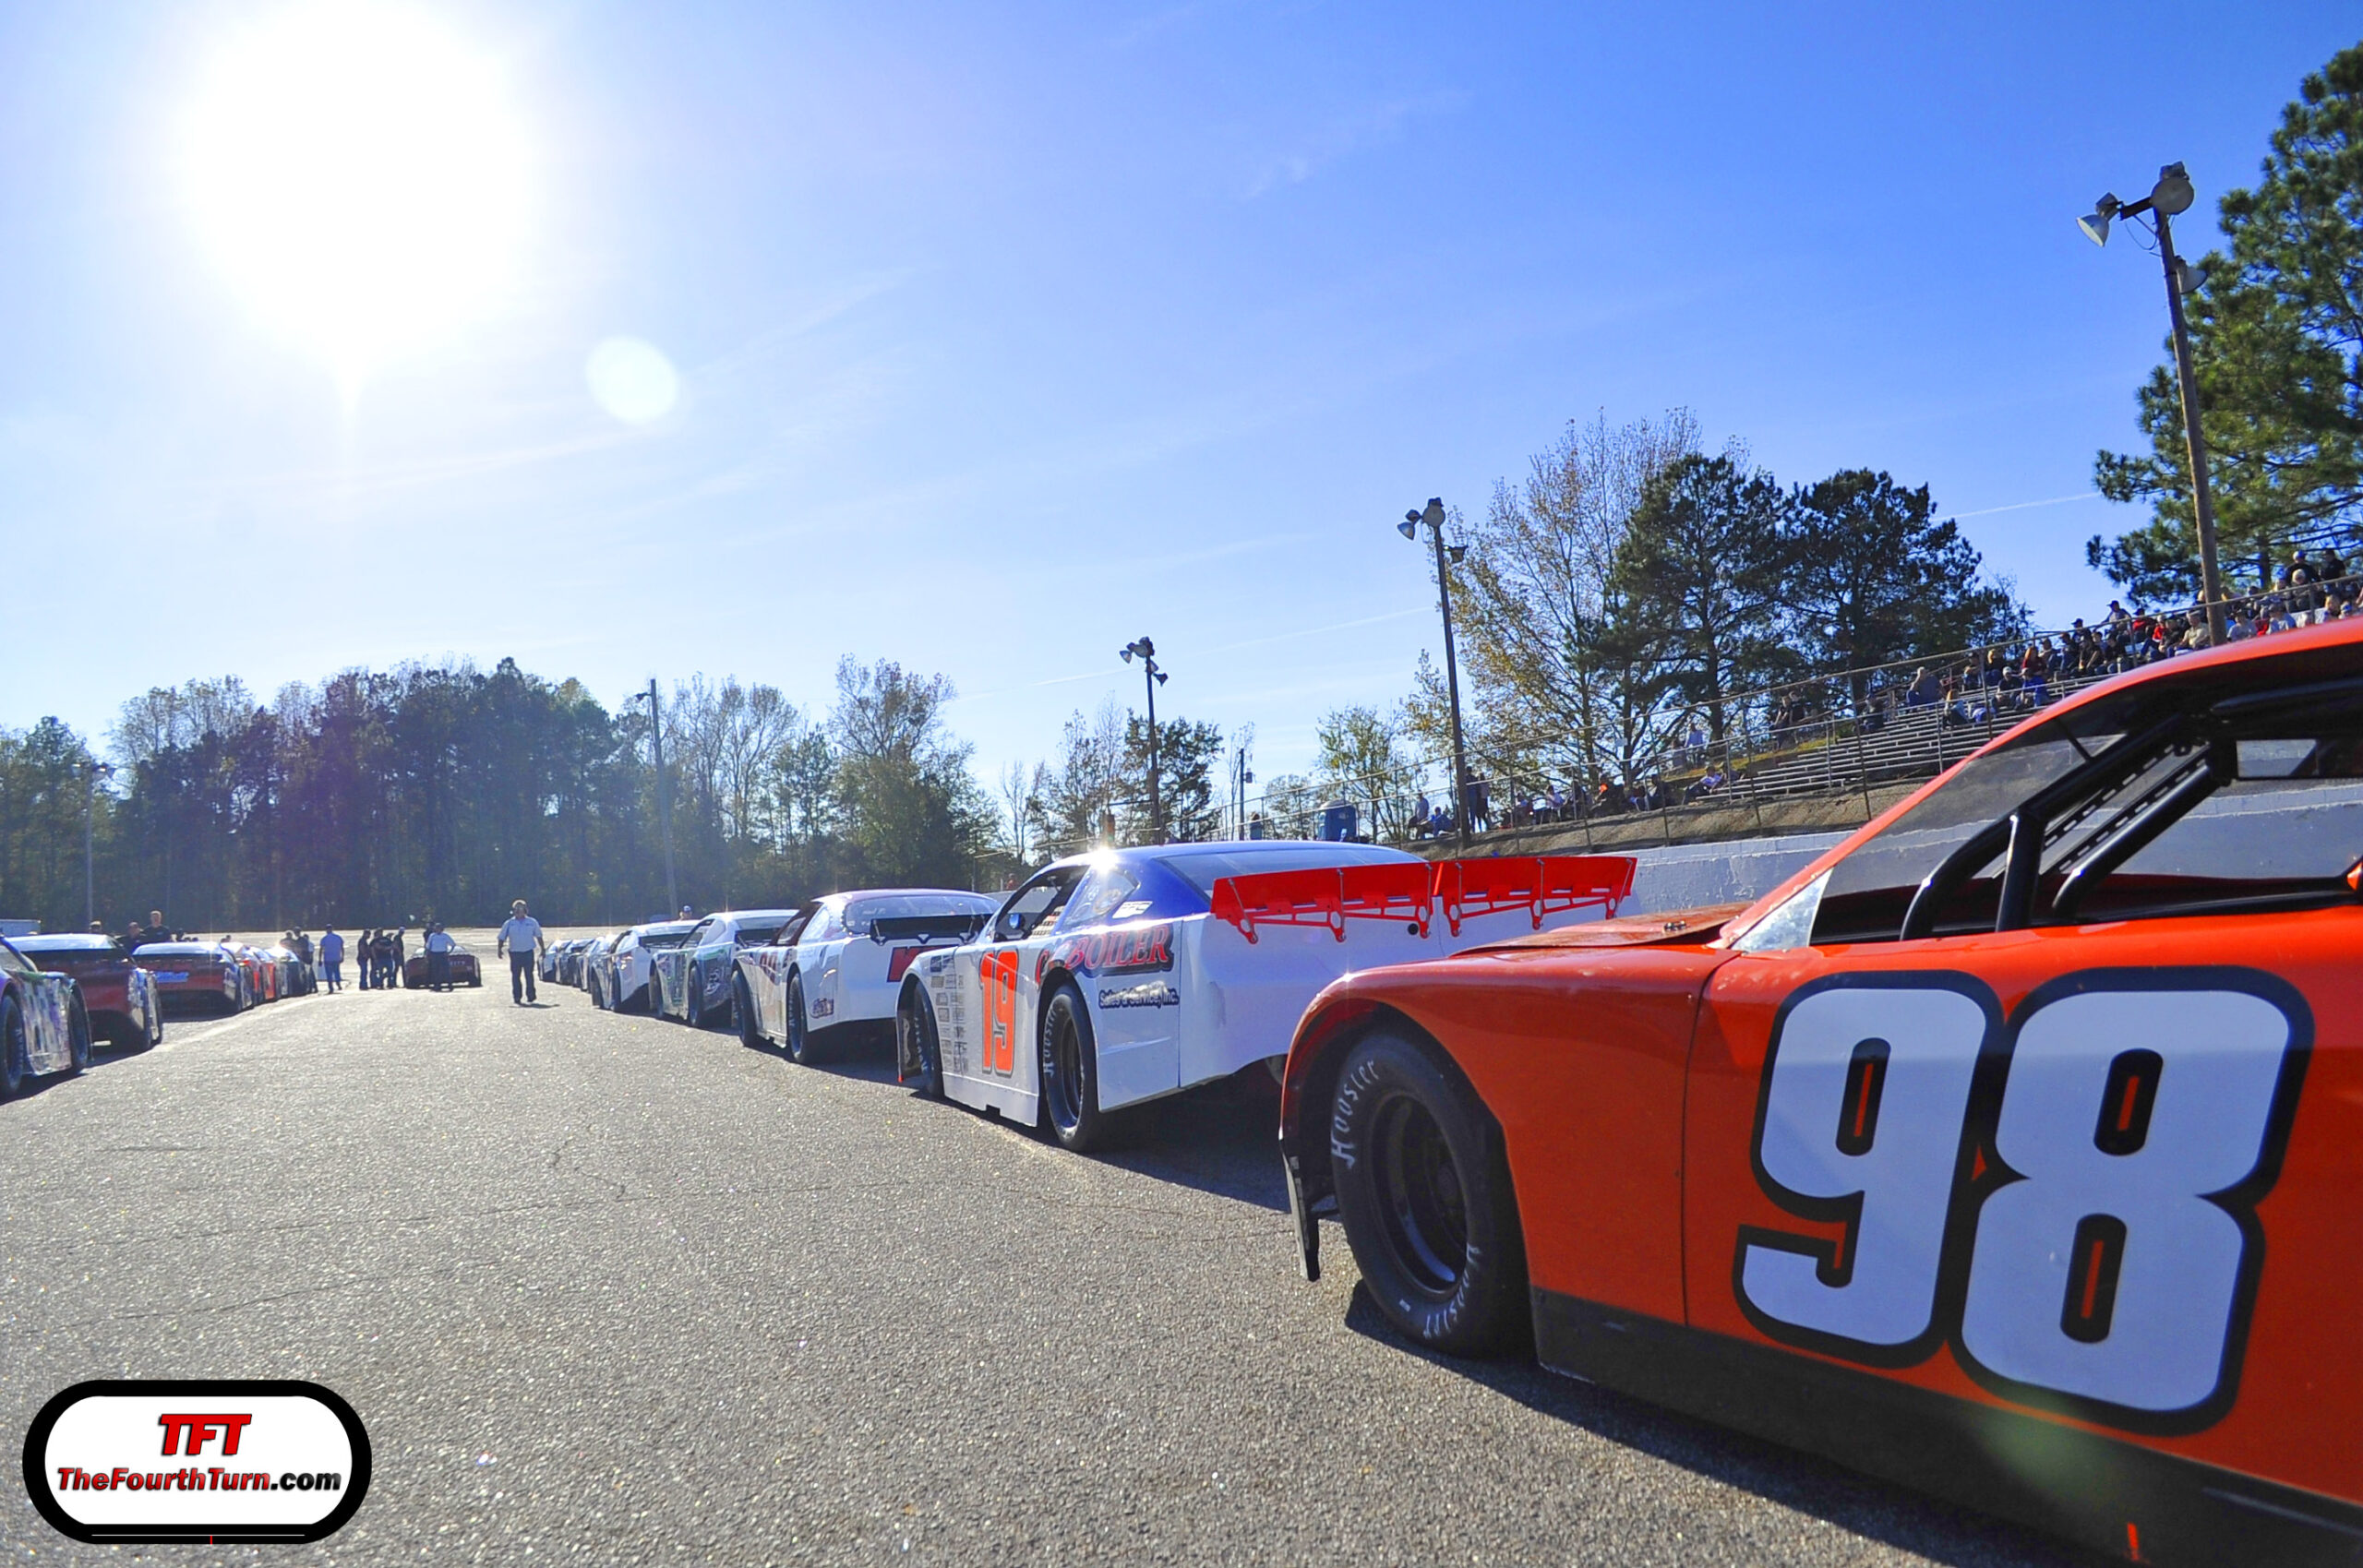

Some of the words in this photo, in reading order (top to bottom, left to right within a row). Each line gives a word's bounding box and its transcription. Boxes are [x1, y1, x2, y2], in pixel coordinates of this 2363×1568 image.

[1064, 925, 1170, 970] BOILER
[979, 950, 1018, 1078] 19
[1733, 965, 2316, 1437] 98
